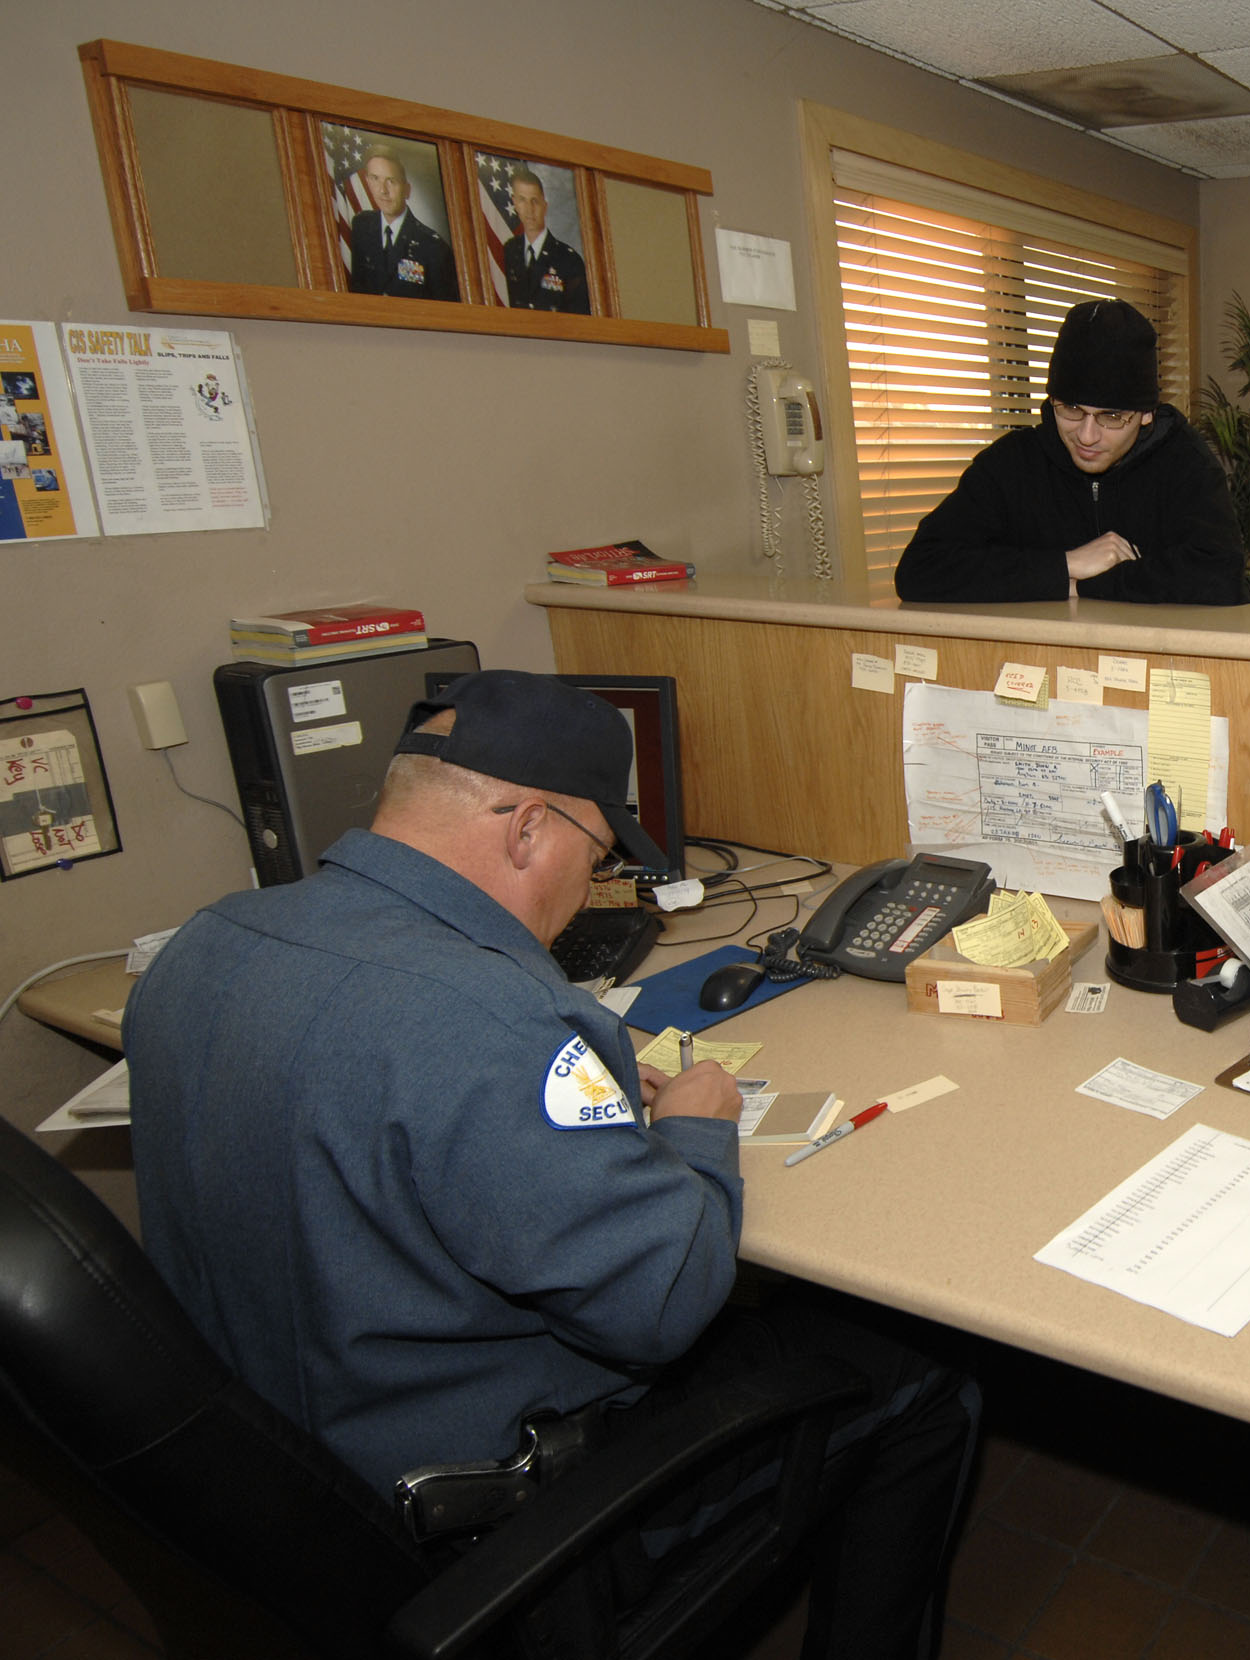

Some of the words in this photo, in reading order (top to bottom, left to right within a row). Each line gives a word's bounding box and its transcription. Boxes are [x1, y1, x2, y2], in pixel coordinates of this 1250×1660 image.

[87, 330, 125, 355] SAFETY
[126, 331, 153, 357] TALK
[355, 623, 376, 635] SRT
[1093, 749, 1124, 757] EXAMPLE
[31, 757, 49, 774] VC
[555, 1040, 588, 1078] CHE
